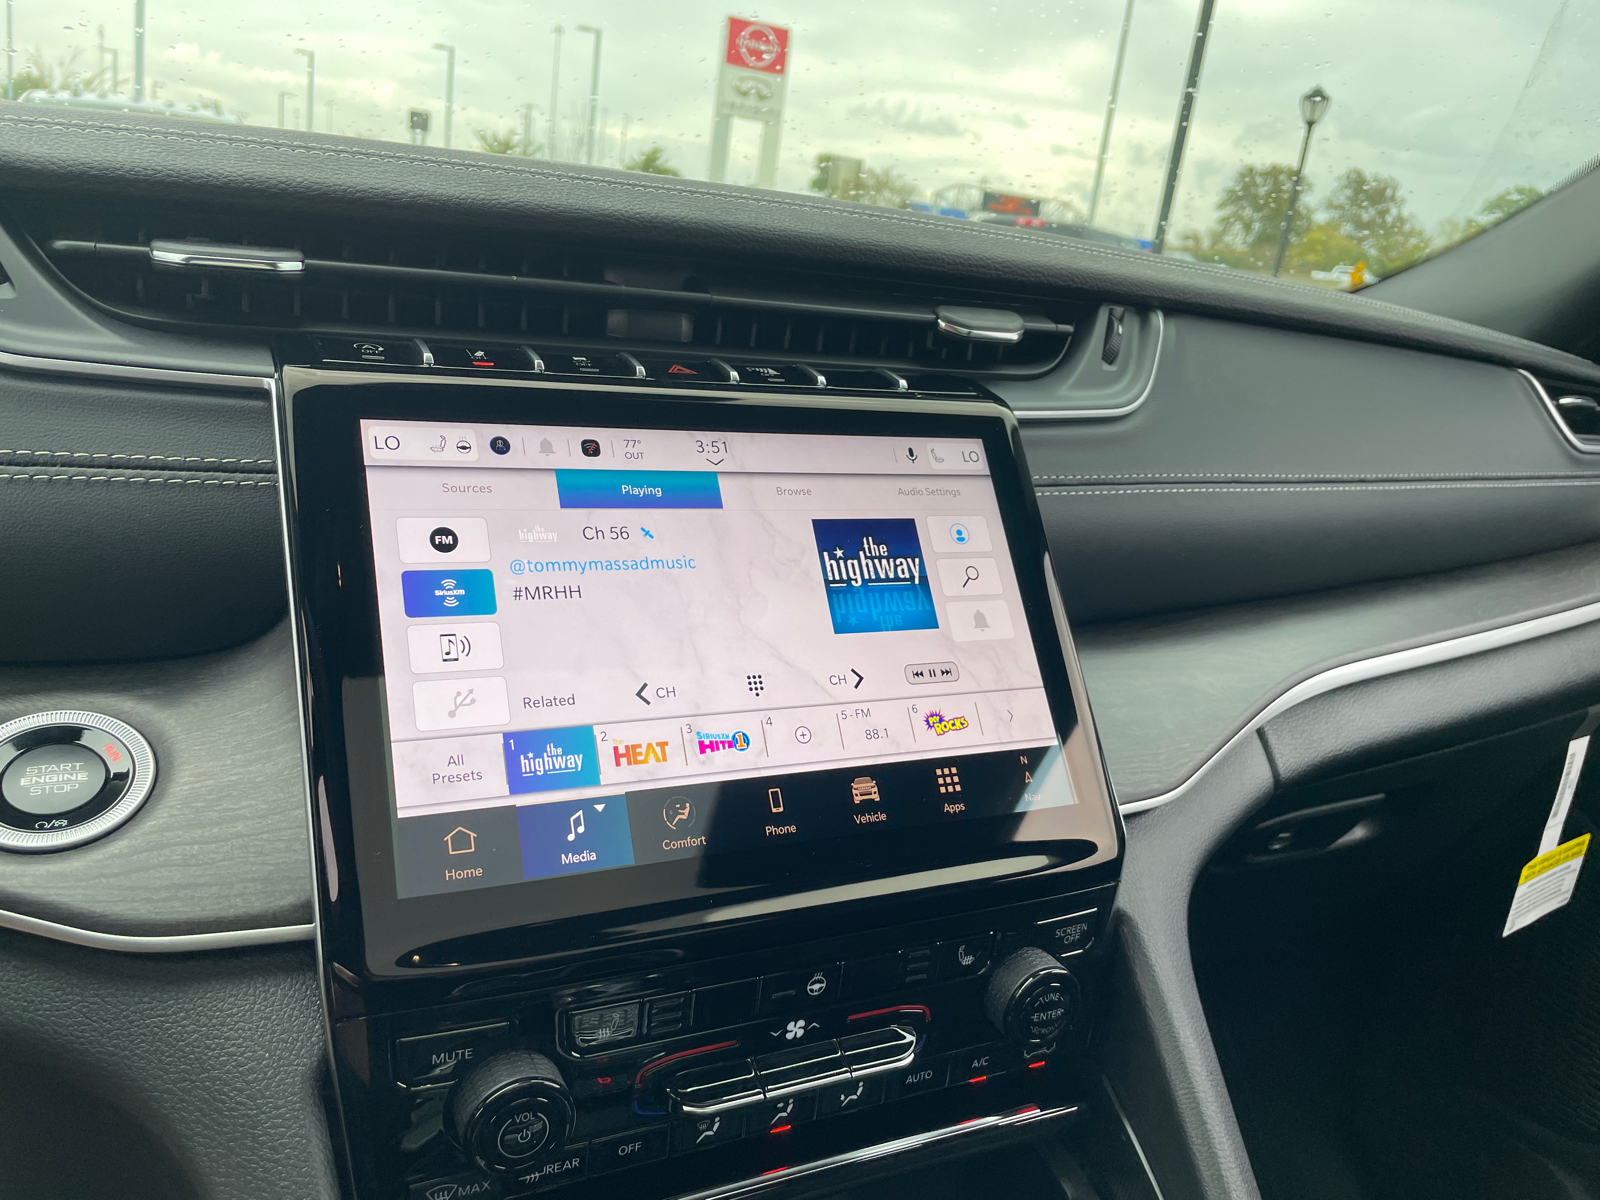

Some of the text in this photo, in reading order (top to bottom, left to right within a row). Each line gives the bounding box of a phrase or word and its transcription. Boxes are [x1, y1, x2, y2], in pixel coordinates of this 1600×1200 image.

[374, 434, 400, 451] LO
[695, 439, 728, 454] 3:51
[624, 452, 644, 460] OUT
[962, 450, 980, 463] LO
[441, 482, 493, 495] Sources
[621, 484, 663, 498] Playing
[775, 486, 813, 497] Browse
[897, 486, 962, 499] Audio Settings
[434, 535, 454, 546] FM
[518, 528, 558, 543] highway
[582, 525, 630, 541] Ch 56
[862, 536, 889, 557] the
[509, 555, 697, 576] @tommymassadmusic
[822, 548, 921, 588] highway
[512, 584, 583, 602] #MRHH
[829, 674, 848, 687] CH
[656, 685, 677, 700] CH
[522, 693, 577, 711] Related
[911, 703, 919, 714] 6
[854, 707, 871, 719] FM
[685, 723, 694, 734] 3
[765, 716, 774, 727] 4
[933, 716, 969, 736] ROCKS
[600, 731, 609, 743] 2
[864, 727, 889, 740] 88.1
[508, 739, 516, 751] 1
[546, 742, 564, 757] the
[103, 742, 122, 764] RUN
[612, 740, 669, 768] HEAT
[1019, 755, 1029, 765] N
[26, 762, 85, 775] START
[446, 754, 466, 769] All
[519, 750, 584, 777] highway
[20, 772, 89, 787] ENGINE
[431, 769, 484, 787] Presets
[29, 783, 79, 796] STOP
[1024, 793, 1042, 802] Nav
[943, 801, 966, 815] Apps
[853, 810, 888, 825] Vehicle
[764, 822, 798, 837] Phone
[661, 834, 707, 851] Comfort
[560, 849, 598, 866] Media
[444, 868, 484, 881] Home
[1055, 923, 1088, 939] SCREEN
[1062, 932, 1081, 944] OFF
[1039, 992, 1060, 1004] TUNE
[431, 1048, 474, 1065] MUTE
[971, 1056, 990, 1069] A/C
[905, 1070, 934, 1085] AUTO
[514, 1112, 536, 1123] VOL
[618, 1141, 642, 1156] OFF
[546, 1158, 580, 1174] REAR
[457, 1180, 491, 1198] MAX
